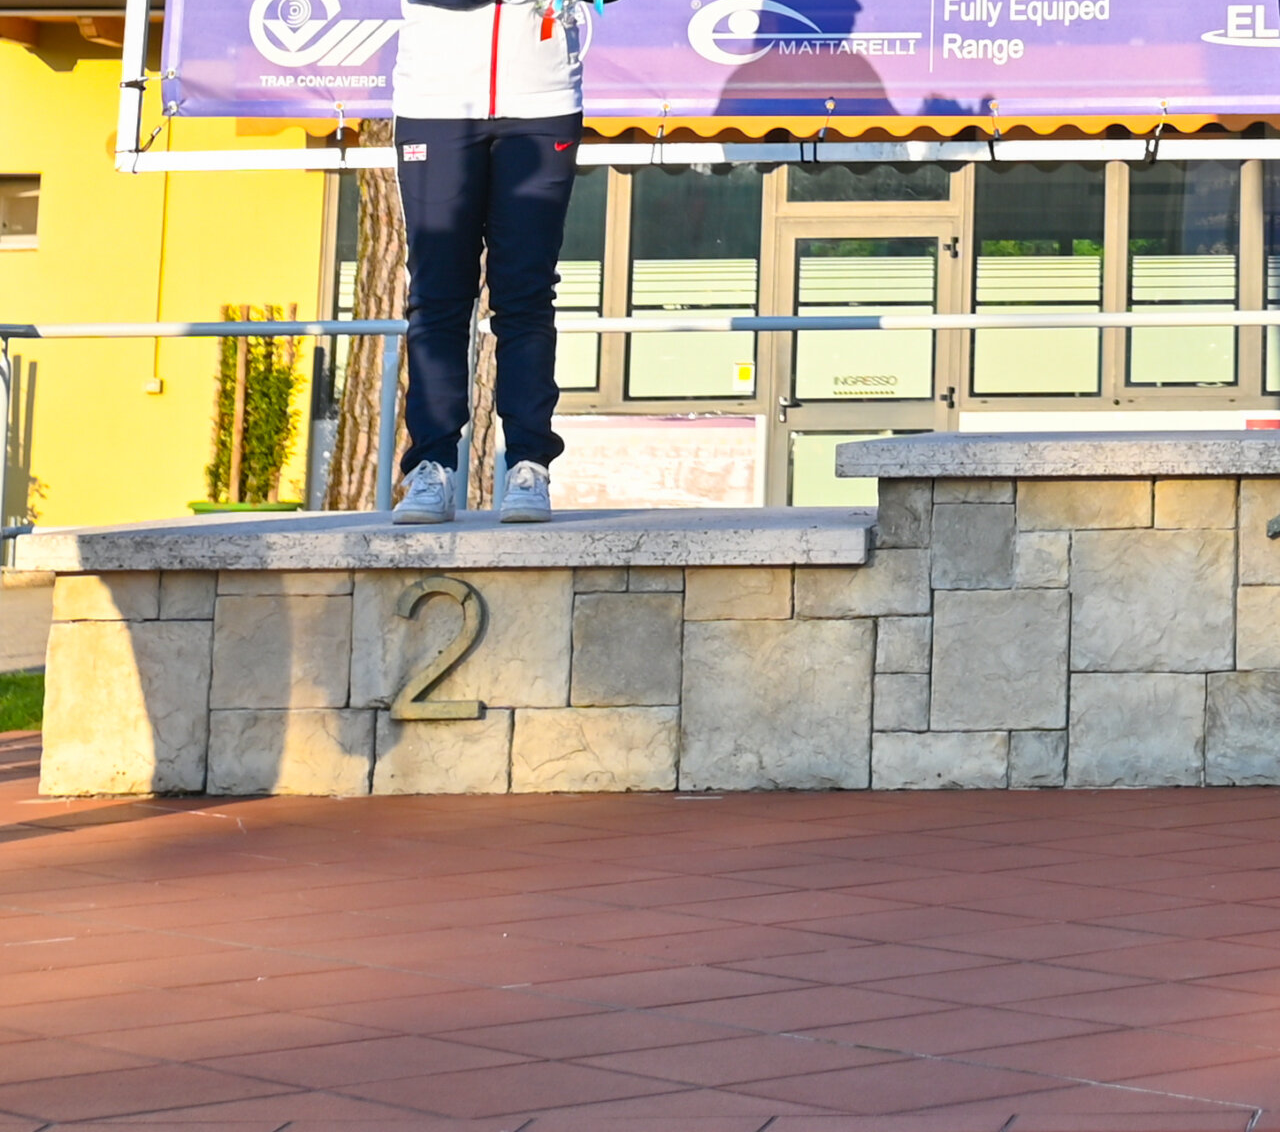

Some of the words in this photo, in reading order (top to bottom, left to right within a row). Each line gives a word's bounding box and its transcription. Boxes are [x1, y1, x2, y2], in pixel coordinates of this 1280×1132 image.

[778, 40, 916, 56] MATTARELLI
[943, 33, 1024, 64] Range
[260, 76, 294, 86] TRAP
[297, 76, 386, 87] CONCAVERDE
[390, 576, 486, 721] 2
